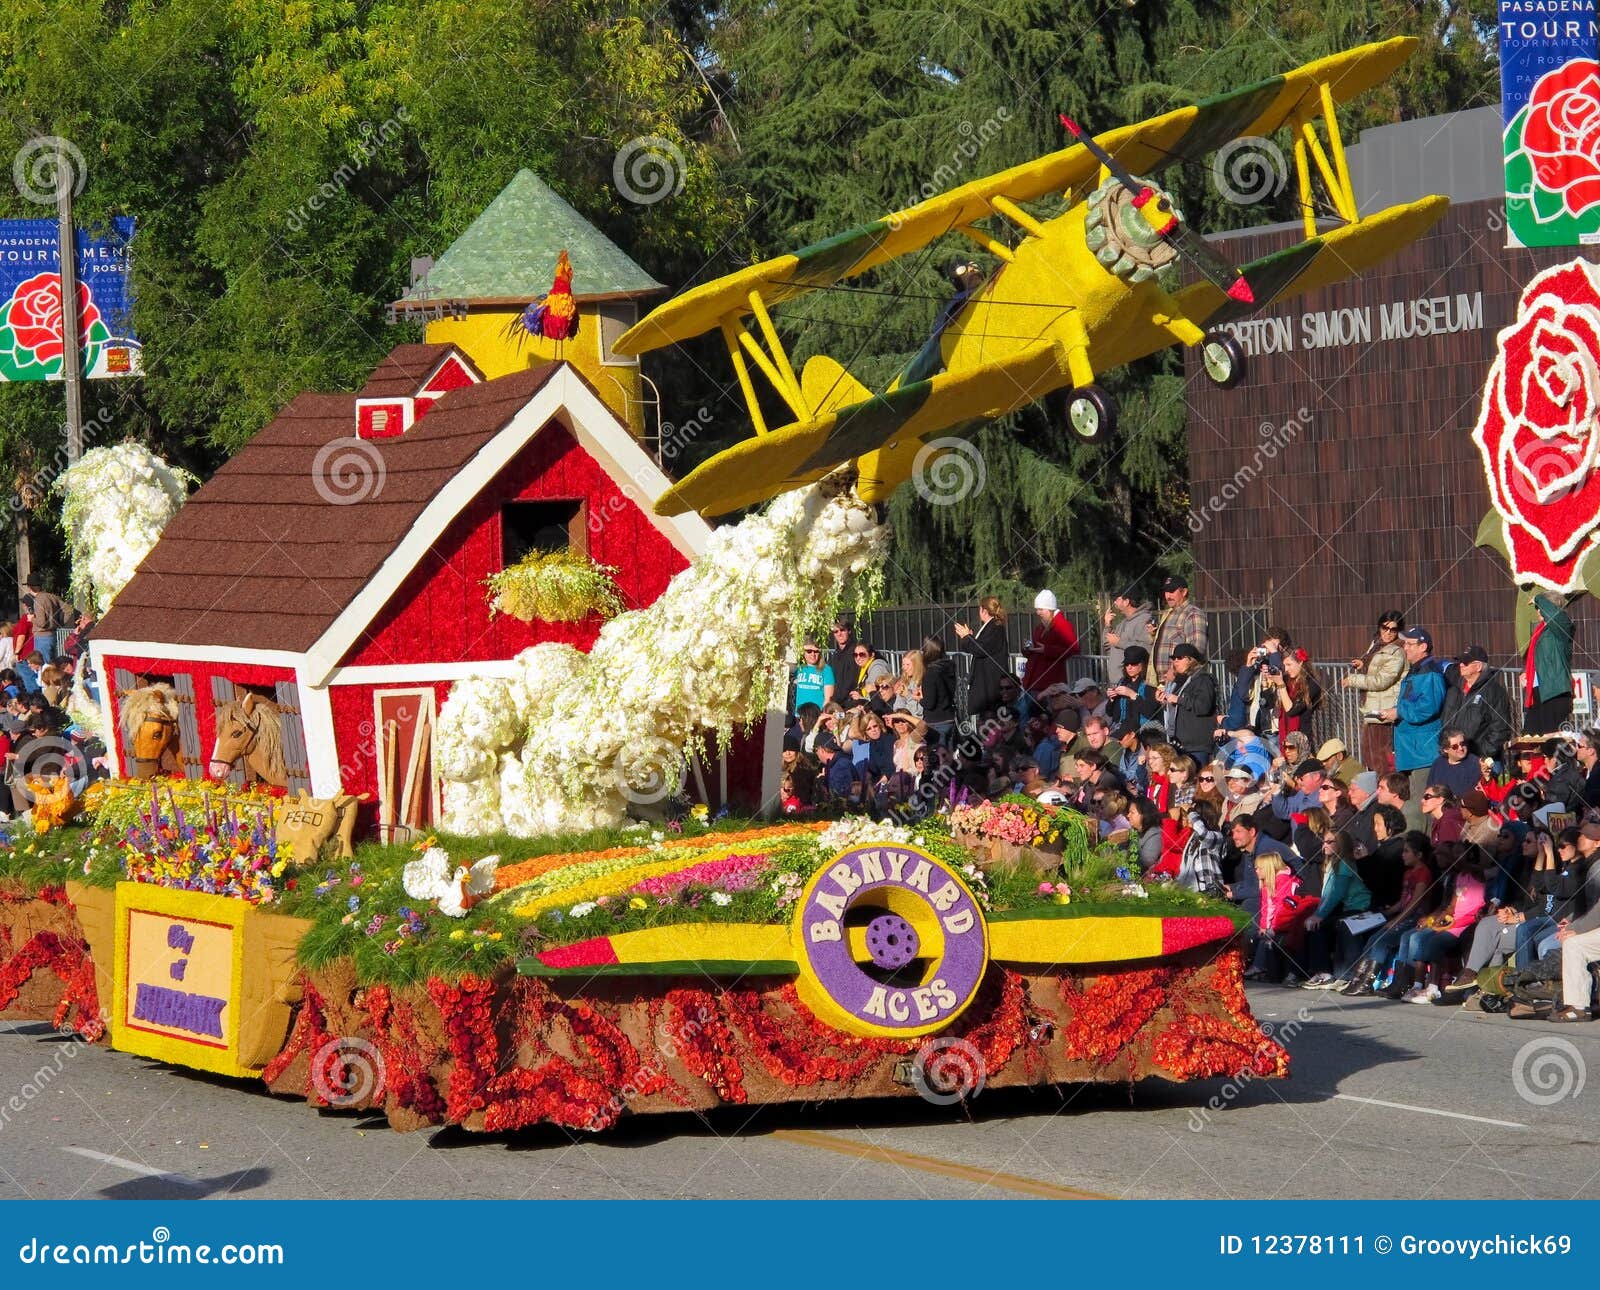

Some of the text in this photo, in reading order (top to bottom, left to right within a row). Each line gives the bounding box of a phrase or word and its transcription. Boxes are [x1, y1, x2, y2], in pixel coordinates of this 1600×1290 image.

[1501, 1, 1595, 12] PASADENA
[1504, 39, 1597, 48] TOURNAMENT
[1302, 306, 1371, 350] SIMON
[1380, 291, 1484, 340] MUSEUM
[283, 810, 324, 827] FEED
[809, 850, 976, 943] BARNYARD
[862, 978, 958, 1022] ACES
